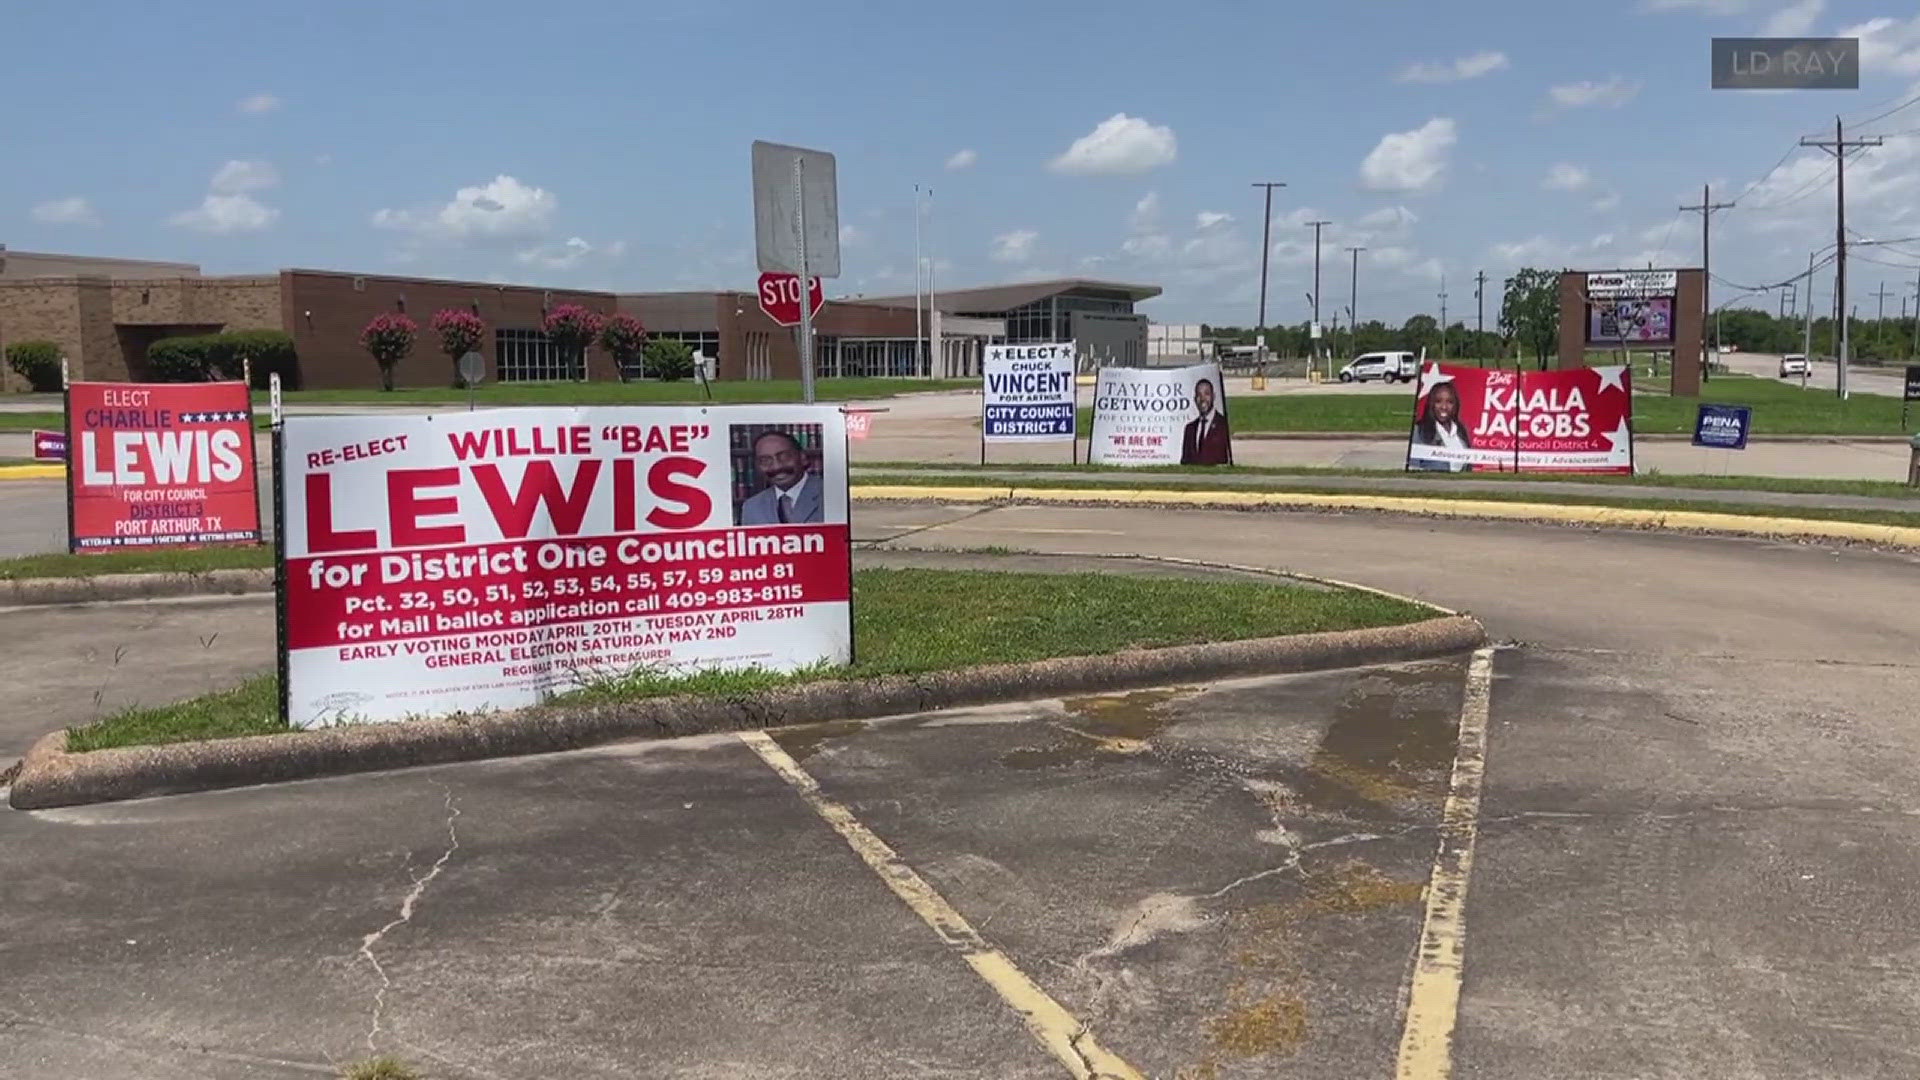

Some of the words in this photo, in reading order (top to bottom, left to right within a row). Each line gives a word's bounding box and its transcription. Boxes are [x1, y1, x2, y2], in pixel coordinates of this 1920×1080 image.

[763, 277, 817, 305] STOP
[1006, 347, 1058, 359] ELECT
[1012, 362, 1052, 371] CHUCK
[988, 372, 1071, 393] VINCENT
[1104, 382, 1183, 398] TAYLOR
[104, 390, 150, 407] ELECT
[1098, 397, 1190, 412] GETWOOD
[1484, 387, 1586, 413] KAALA
[85, 410, 172, 428] CHARLIE
[987, 408, 1016, 419] CITY
[1020, 406, 1072, 419] COUNCIL
[994, 421, 1056, 434] DISTRICT
[1058, 421, 1067, 432] 4
[1473, 412, 1590, 438] JACOBS
[306, 435, 408, 469] RE-ELECT
[448, 425, 592, 460] WILLIE
[1473, 438, 1487, 446] for
[1489, 438, 1509, 450] City
[1552, 440, 1588, 450] District
[82, 429, 244, 486] LEWIS
[124, 489, 143, 502] FOR
[145, 489, 165, 501] CITY
[167, 488, 207, 500] COUNCIL
[306, 456, 712, 554] LEWIS
[130, 502, 192, 520] DISTRICT
[115, 520, 148, 535] PORT
[206, 516, 222, 532] TX
[308, 560, 368, 590] for
[381, 547, 528, 584] District
[537, 543, 606, 570] One
[617, 532, 824, 564] Councilman
[346, 596, 392, 615] Pct.
[400, 592, 435, 611] 32,
[443, 588, 479, 607] 50,
[486, 585, 516, 602] 51,
[523, 581, 549, 599] 52,
[554, 578, 584, 595] 53,
[590, 576, 620, 593] 54,
[627, 573, 657, 590] 55,
[663, 570, 693, 588] 57,
[698, 568, 723, 584] 59
[729, 566, 767, 581] and
[772, 563, 795, 578] 81
[338, 622, 374, 640] for
[381, 616, 430, 636] Mail
[436, 609, 502, 631] ballot
[510, 600, 620, 625] application
[625, 594, 660, 613] call
[665, 584, 803, 608] 409-983-8115
[339, 644, 398, 662] EARLY
[404, 637, 471, 656] VOTING
[476, 630, 543, 650] MONDAY
[547, 624, 588, 642] APRIL
[593, 620, 632, 637] 20TH
[646, 613, 715, 634] TUESDAY
[720, 609, 763, 627] APRIL
[767, 606, 804, 620] 28TH
[425, 650, 503, 669] GENERAL
[510, 642, 578, 660] ELECTION
[581, 632, 663, 653] SATURDAY
[669, 628, 701, 642] MAY
[706, 625, 736, 638] 2ND
[503, 661, 552, 677] REGINALD
[606, 649, 672, 664] TREASURER
